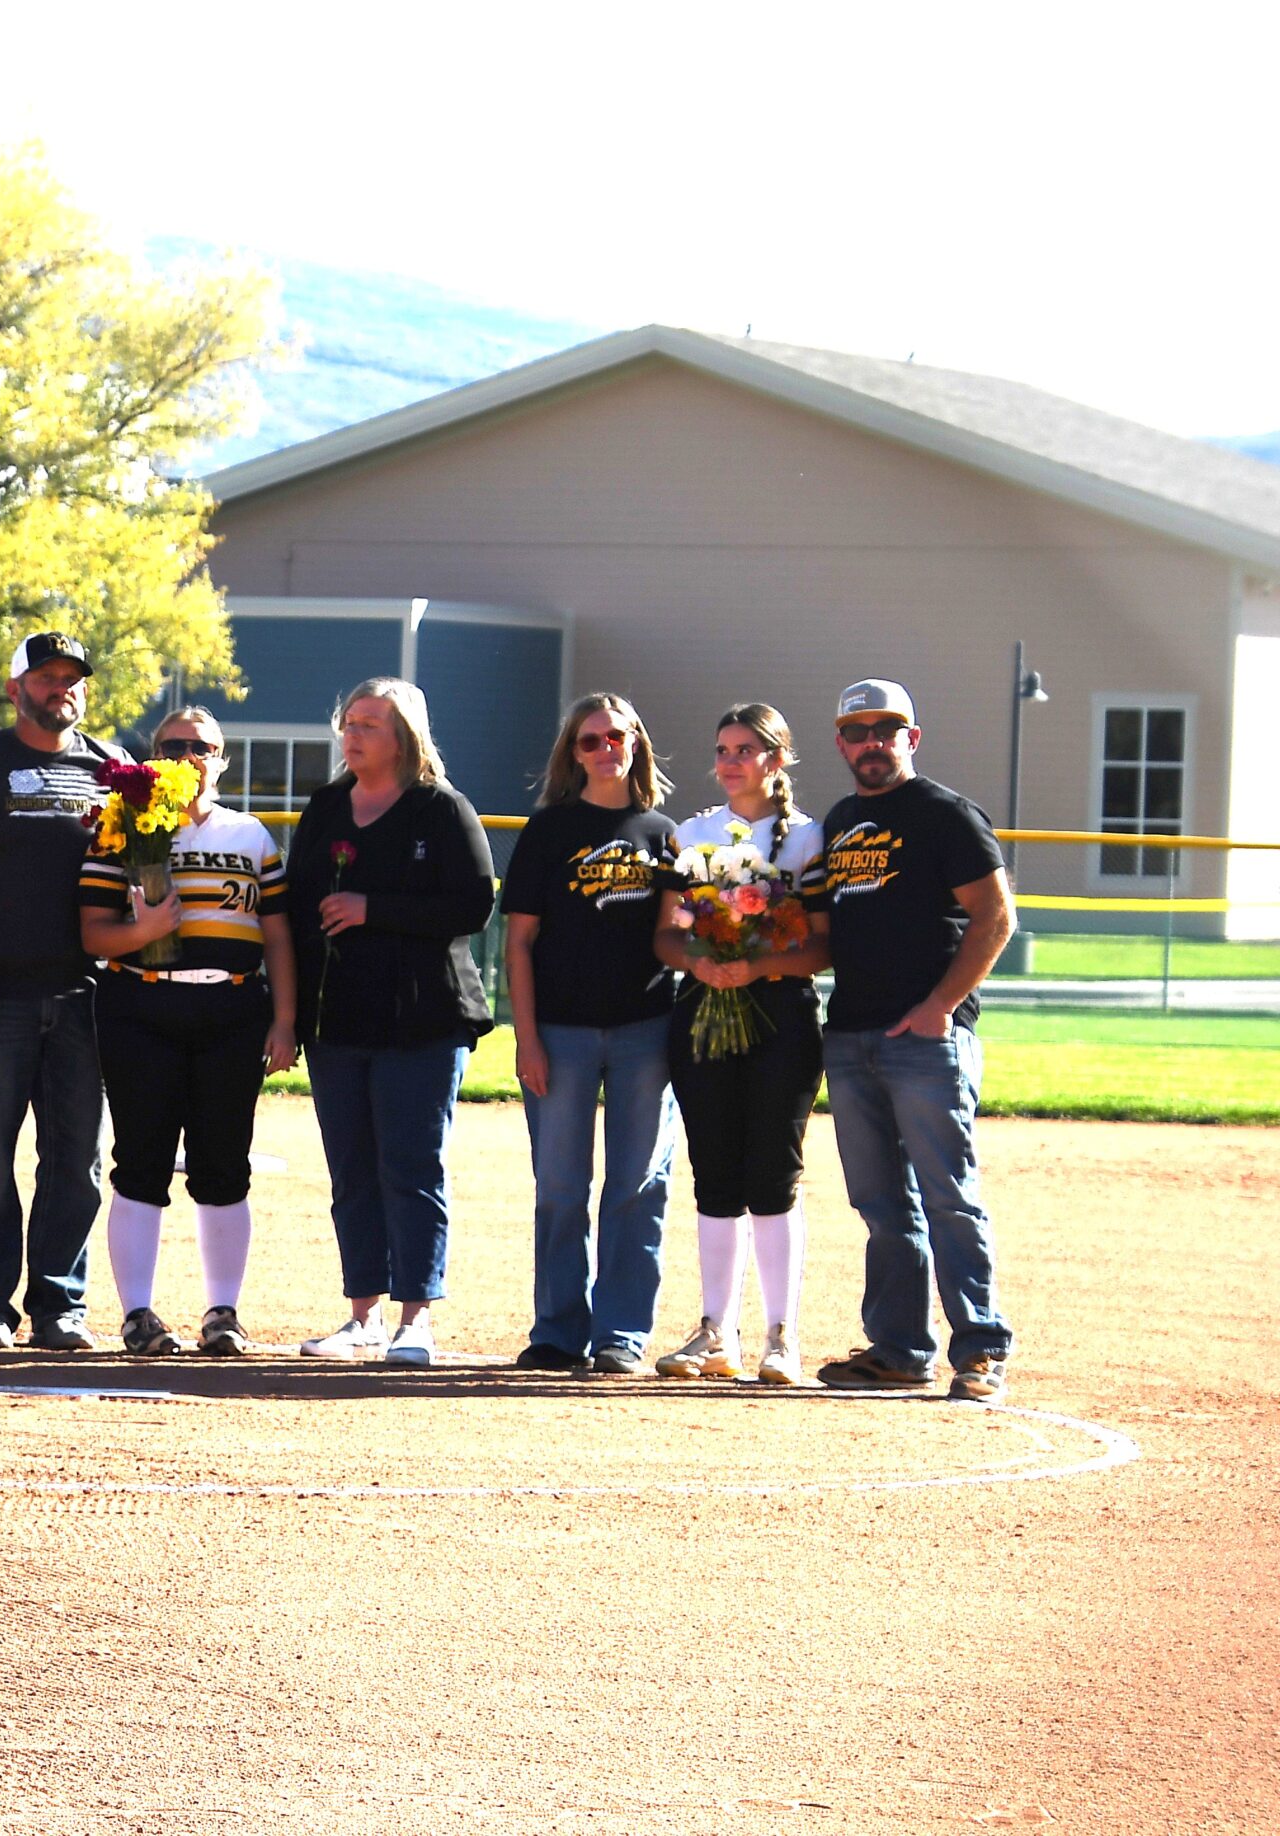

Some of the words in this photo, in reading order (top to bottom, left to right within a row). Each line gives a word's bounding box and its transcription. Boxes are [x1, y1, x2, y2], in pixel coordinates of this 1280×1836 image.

[170, 851, 253, 871] EEKER
[828, 849, 890, 870] COWBOYS
[577, 863, 653, 880] COWBOYS
[219, 880, 258, 913] 20
